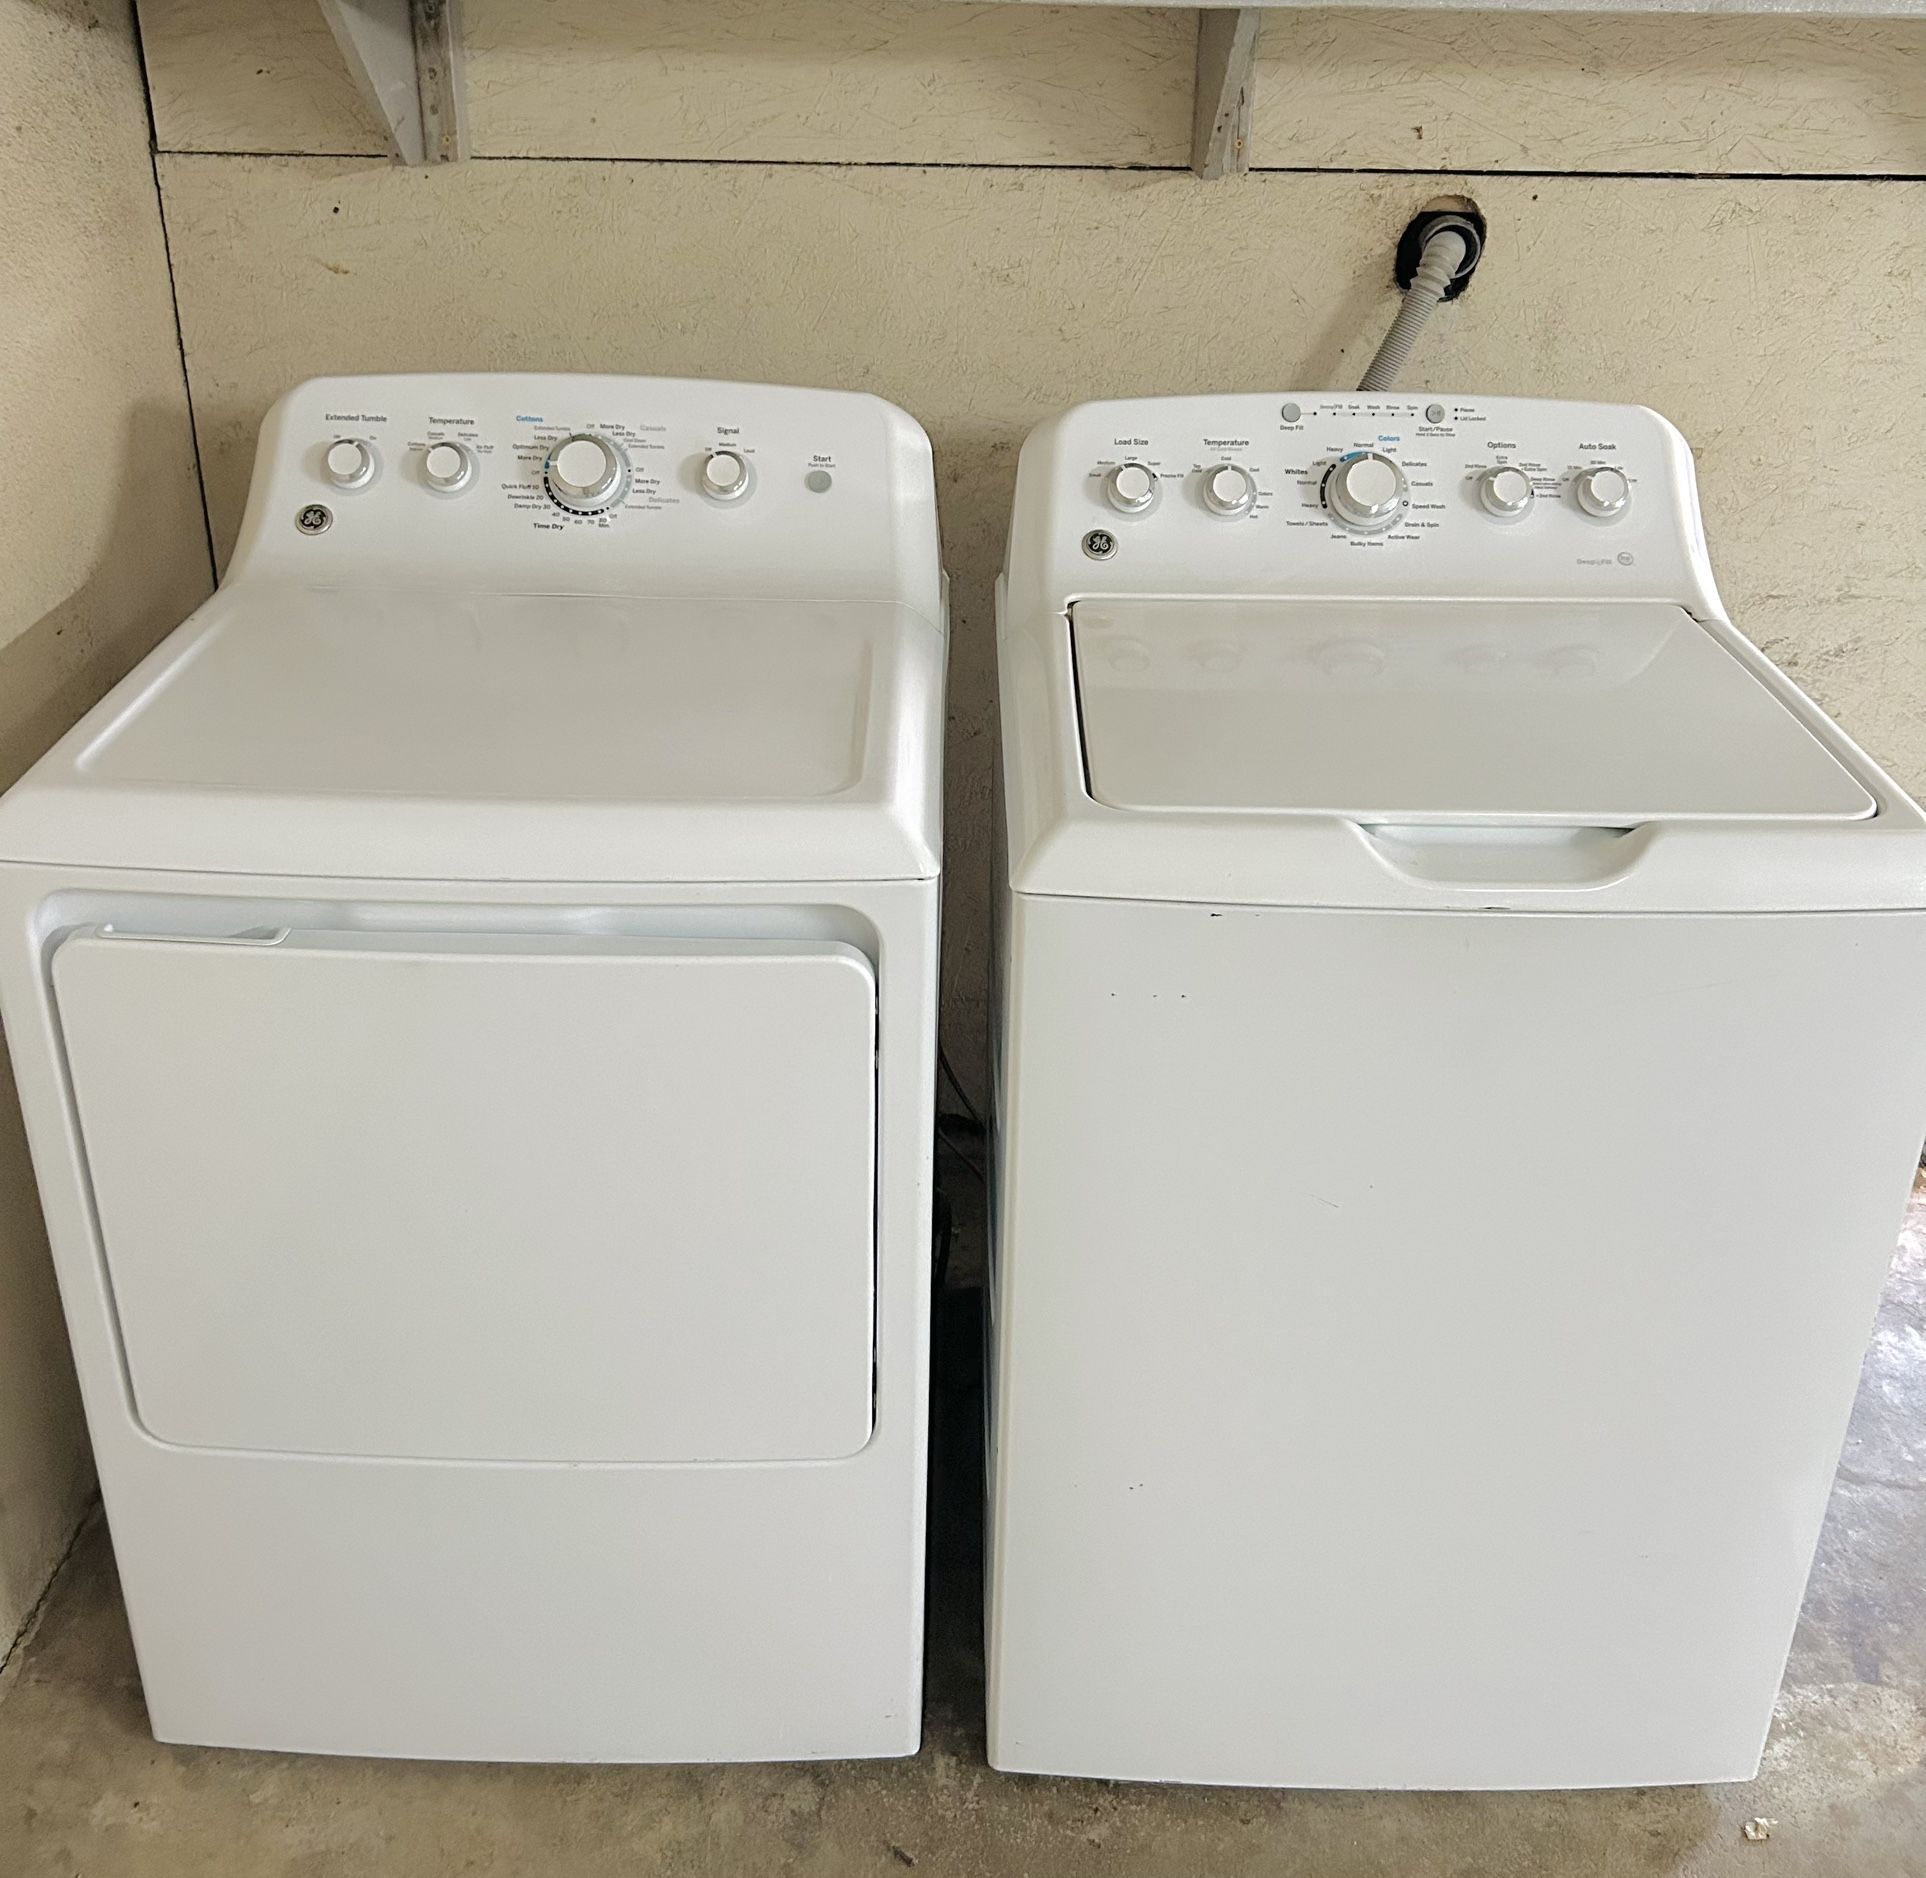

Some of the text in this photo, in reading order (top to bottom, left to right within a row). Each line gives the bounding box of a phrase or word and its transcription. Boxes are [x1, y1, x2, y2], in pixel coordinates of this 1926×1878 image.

[325, 414, 359, 422] Extended
[429, 417, 474, 426] Temperature
[1488, 442, 1516, 450] Options
